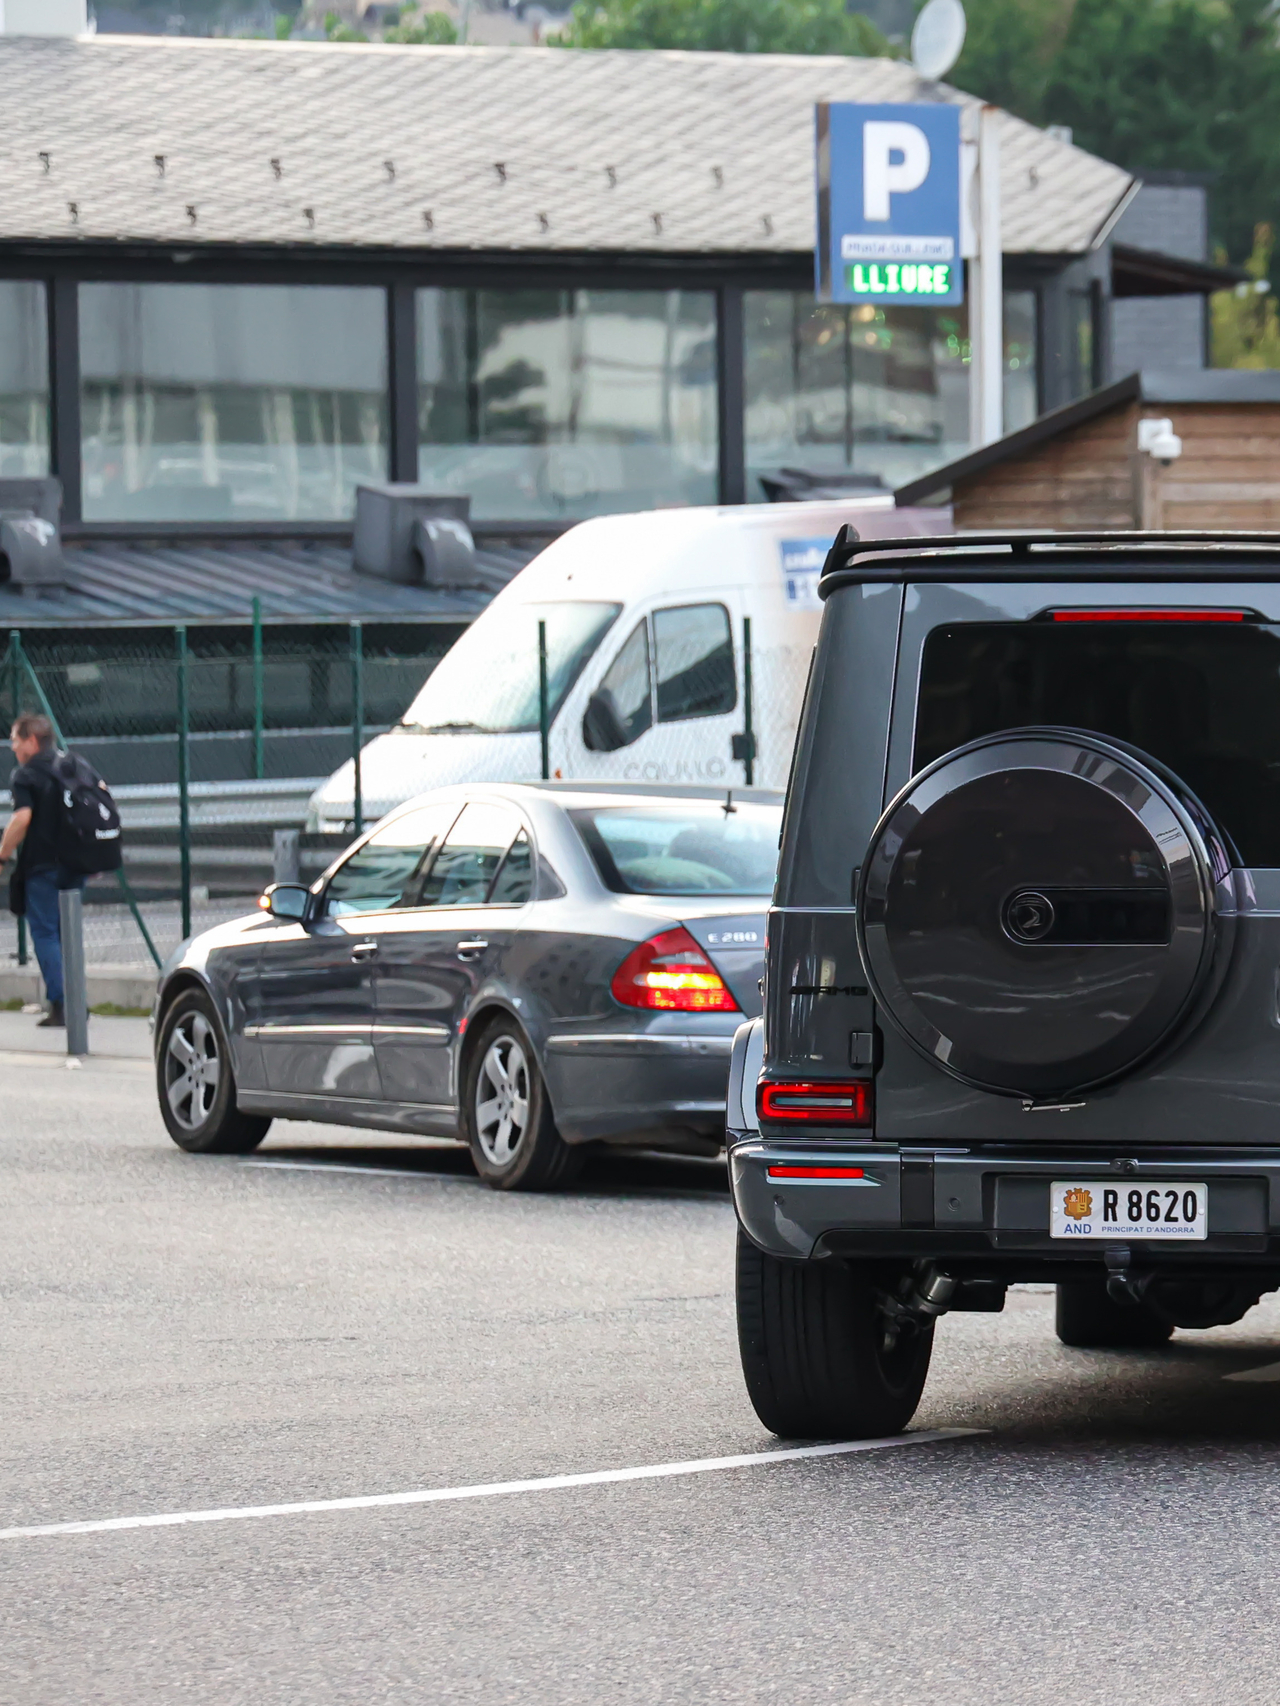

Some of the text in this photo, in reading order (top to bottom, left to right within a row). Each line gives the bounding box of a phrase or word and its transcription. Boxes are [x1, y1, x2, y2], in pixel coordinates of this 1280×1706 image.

[863, 120, 930, 222] P
[853, 264, 950, 294] LLIURE
[707, 931, 758, 943] E 280
[1103, 1189, 1197, 1223] R 8620
[1063, 1223, 1092, 1234] AND
[1146, 1226, 1195, 1234] D'ANDORRA
